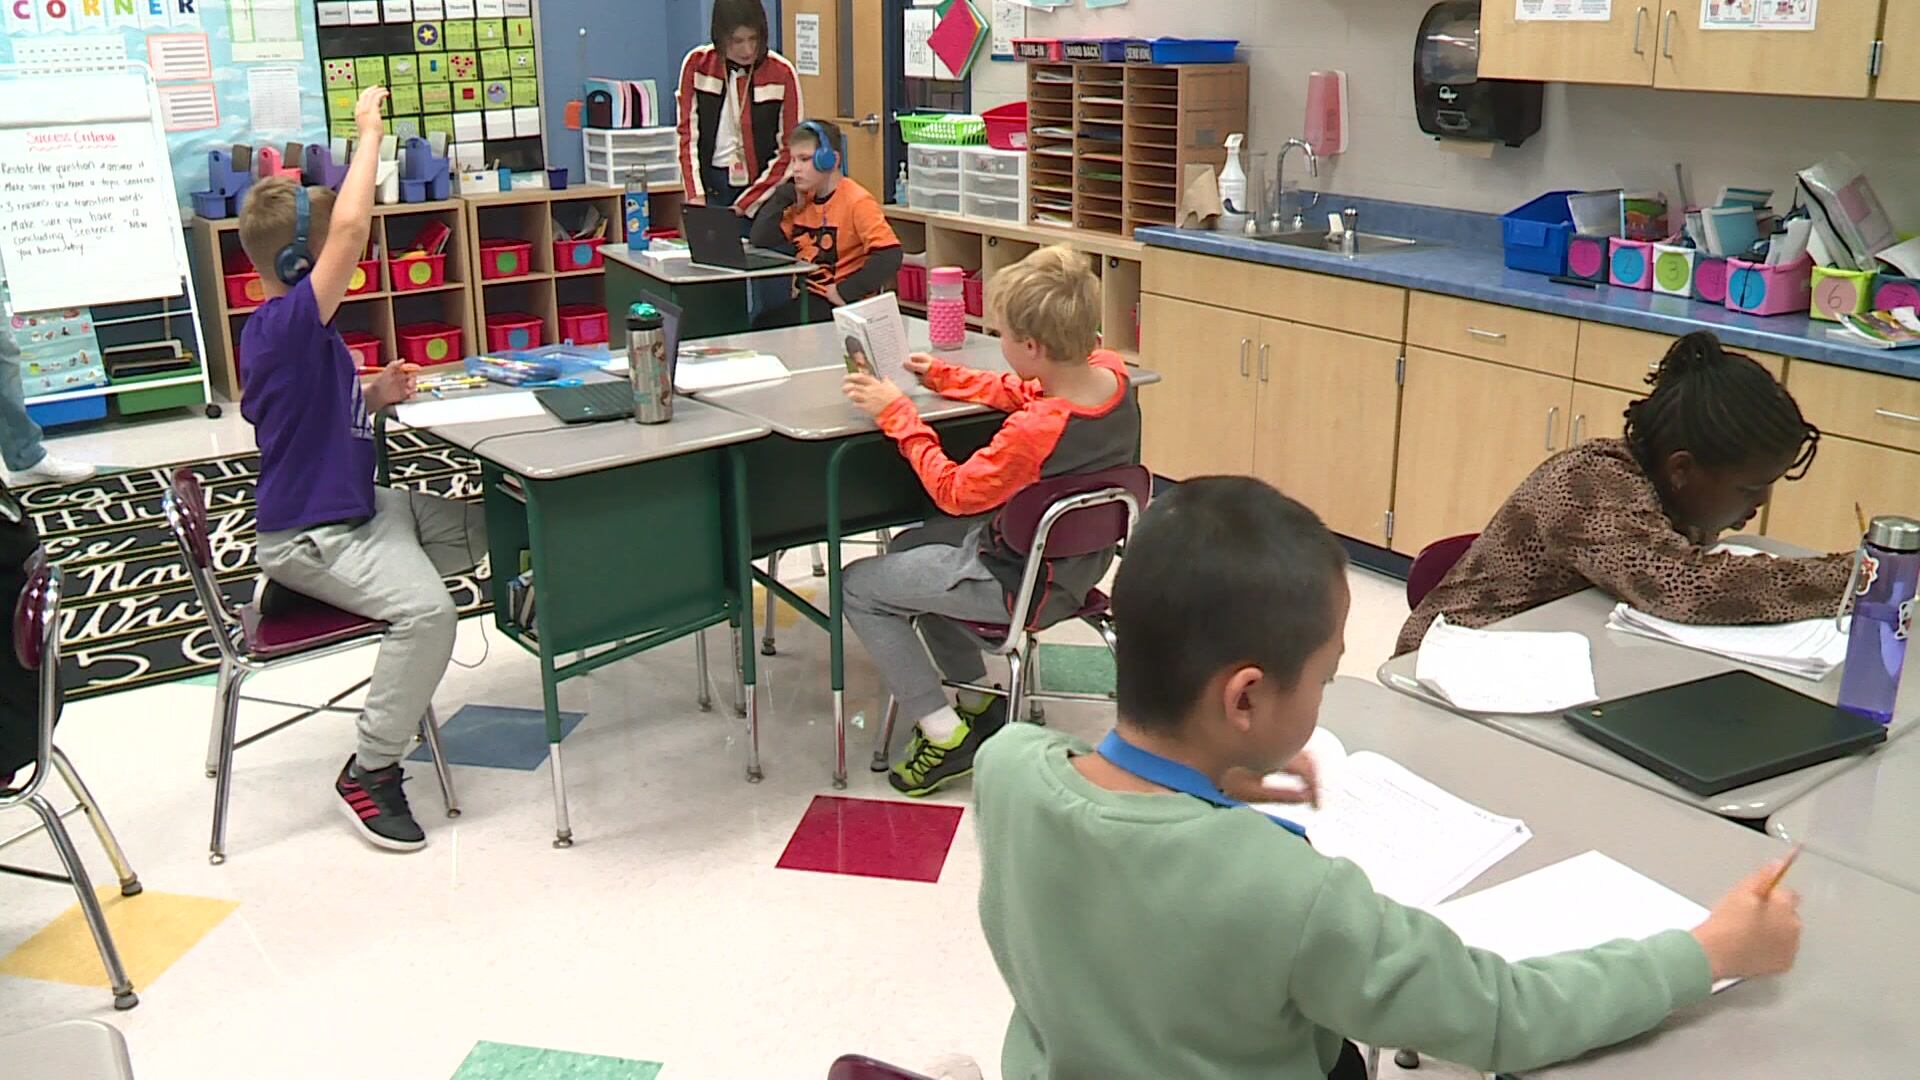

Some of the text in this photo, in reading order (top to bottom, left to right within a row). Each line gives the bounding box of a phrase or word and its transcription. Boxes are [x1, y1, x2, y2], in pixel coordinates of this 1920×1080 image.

[13, 0, 196, 19] CORNER
[27, 130, 117, 144] Success Criteria
[1, 163, 34, 174] Restate
[38, 162, 52, 173] the
[56, 160, 96, 179] question
[4, 182, 25, 192] Make
[28, 183, 46, 191] sure
[51, 181, 66, 193] you
[11, 218, 34, 232] Make
[40, 217, 62, 227] sure
[66, 215, 83, 230] you
[89, 211, 113, 222] have
[13, 232, 65, 248] concluding
[74, 225, 116, 238] sentence
[1623, 252, 1634, 276] 2
[1665, 260, 1679, 281] 3
[1827, 284, 1842, 309] 6
